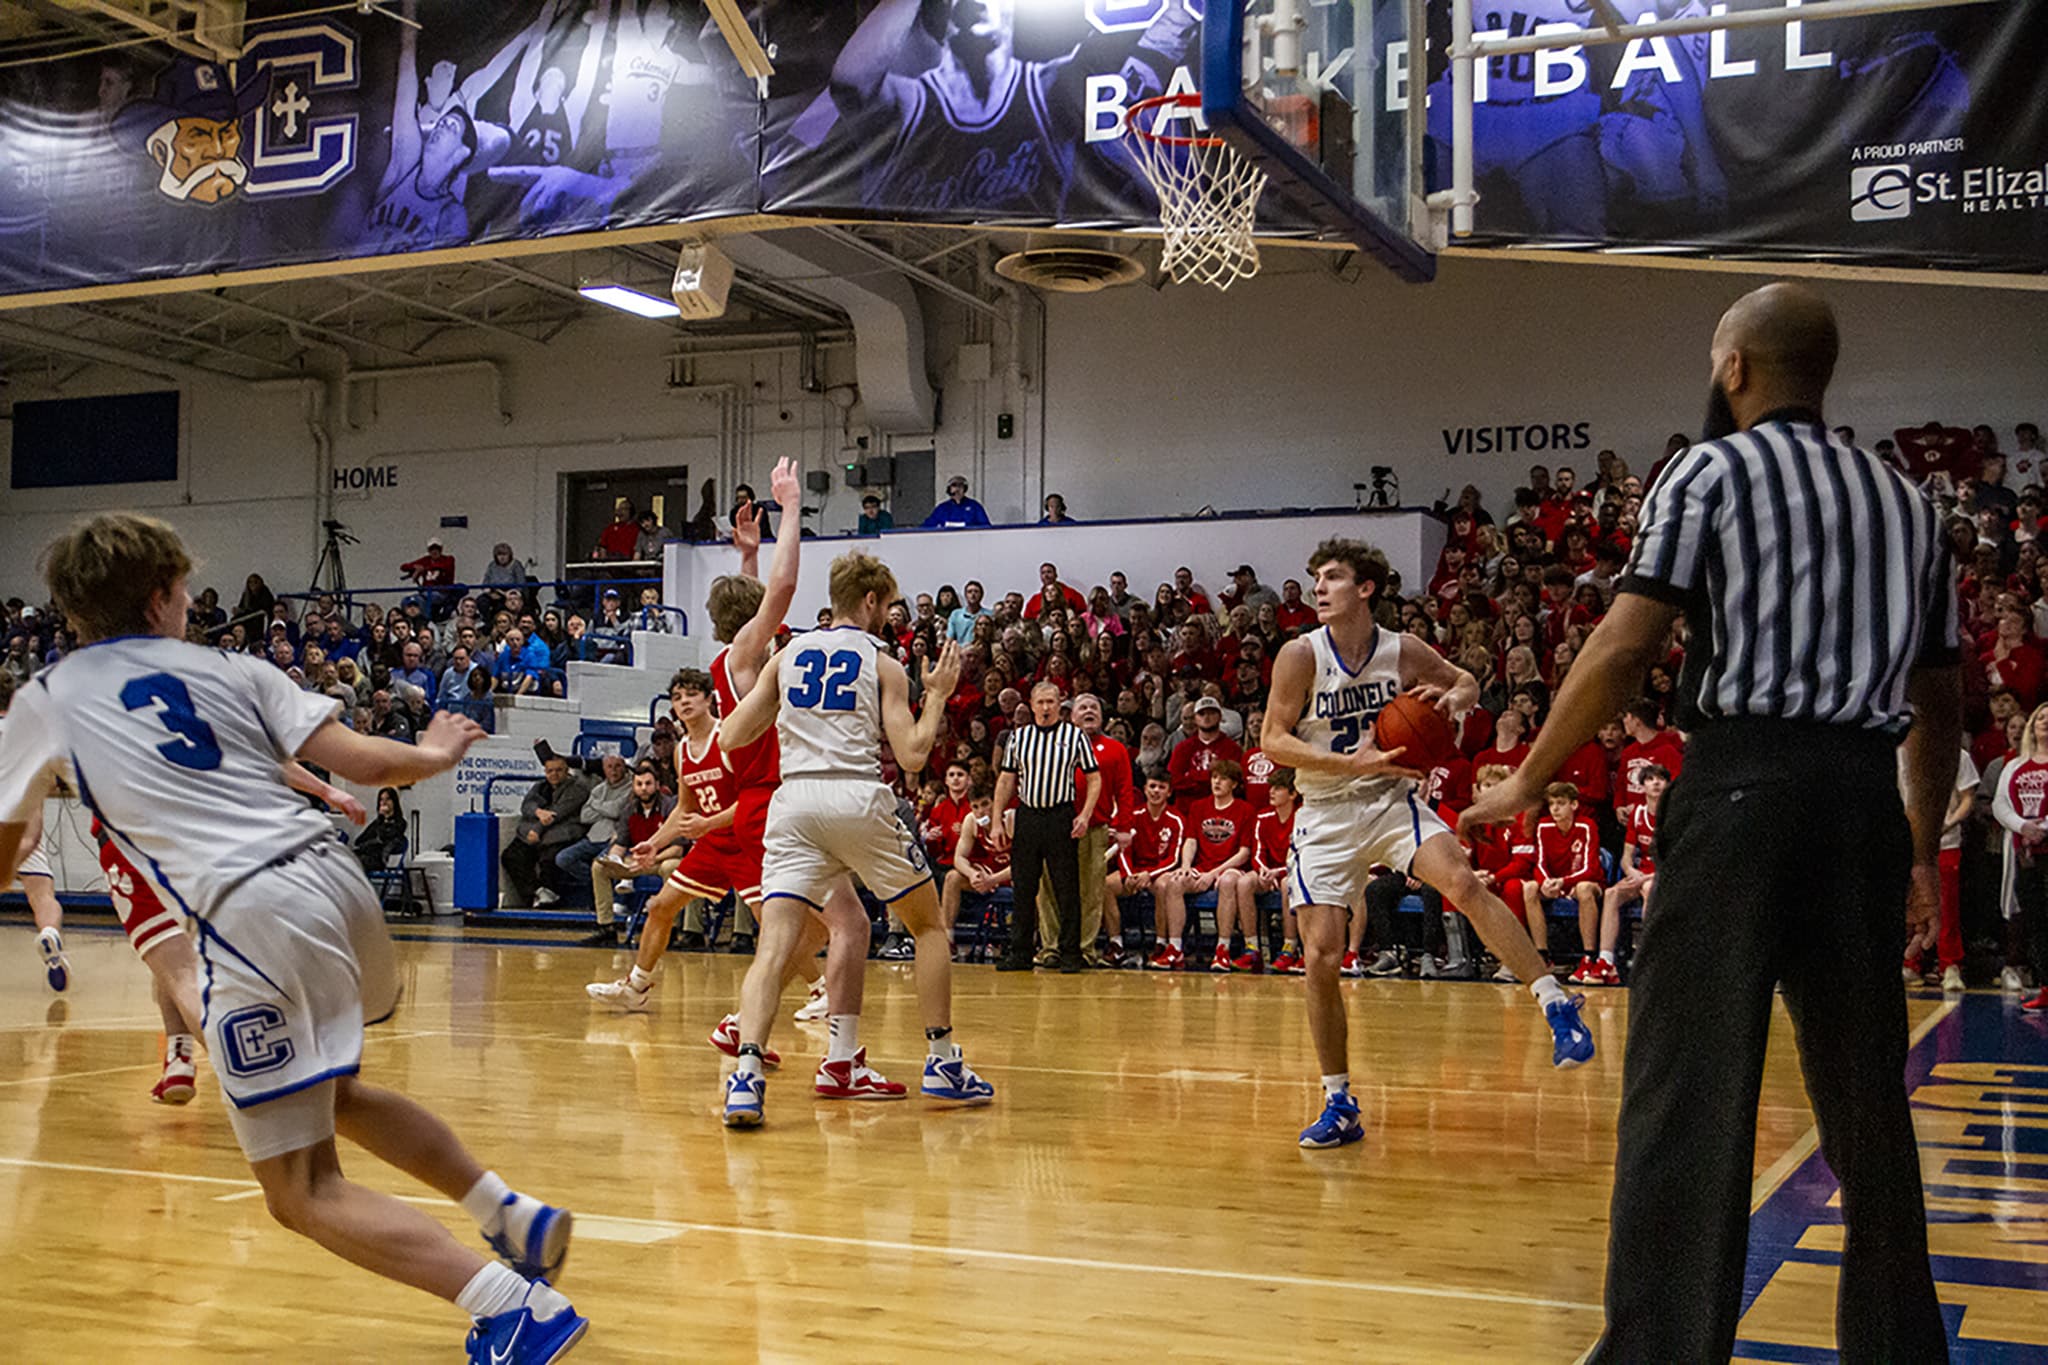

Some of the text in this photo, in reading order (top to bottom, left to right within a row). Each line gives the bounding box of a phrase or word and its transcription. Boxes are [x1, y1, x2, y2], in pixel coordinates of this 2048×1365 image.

[1085, 0, 1833, 141] BAKETBALL
[243, 20, 361, 195] C
[1851, 137, 1964, 161] A PROUD PARTNER
[1916, 171, 1957, 203] St.
[1963, 162, 2048, 199] Eliza
[1963, 195, 2048, 213] HEALT
[1443, 422, 1591, 454] VISITORS
[333, 465, 398, 489] HOME
[787, 649, 862, 711] 32
[1316, 679, 1397, 719] COLONELS
[119, 672, 223, 771] 3
[695, 785, 722, 813] 22
